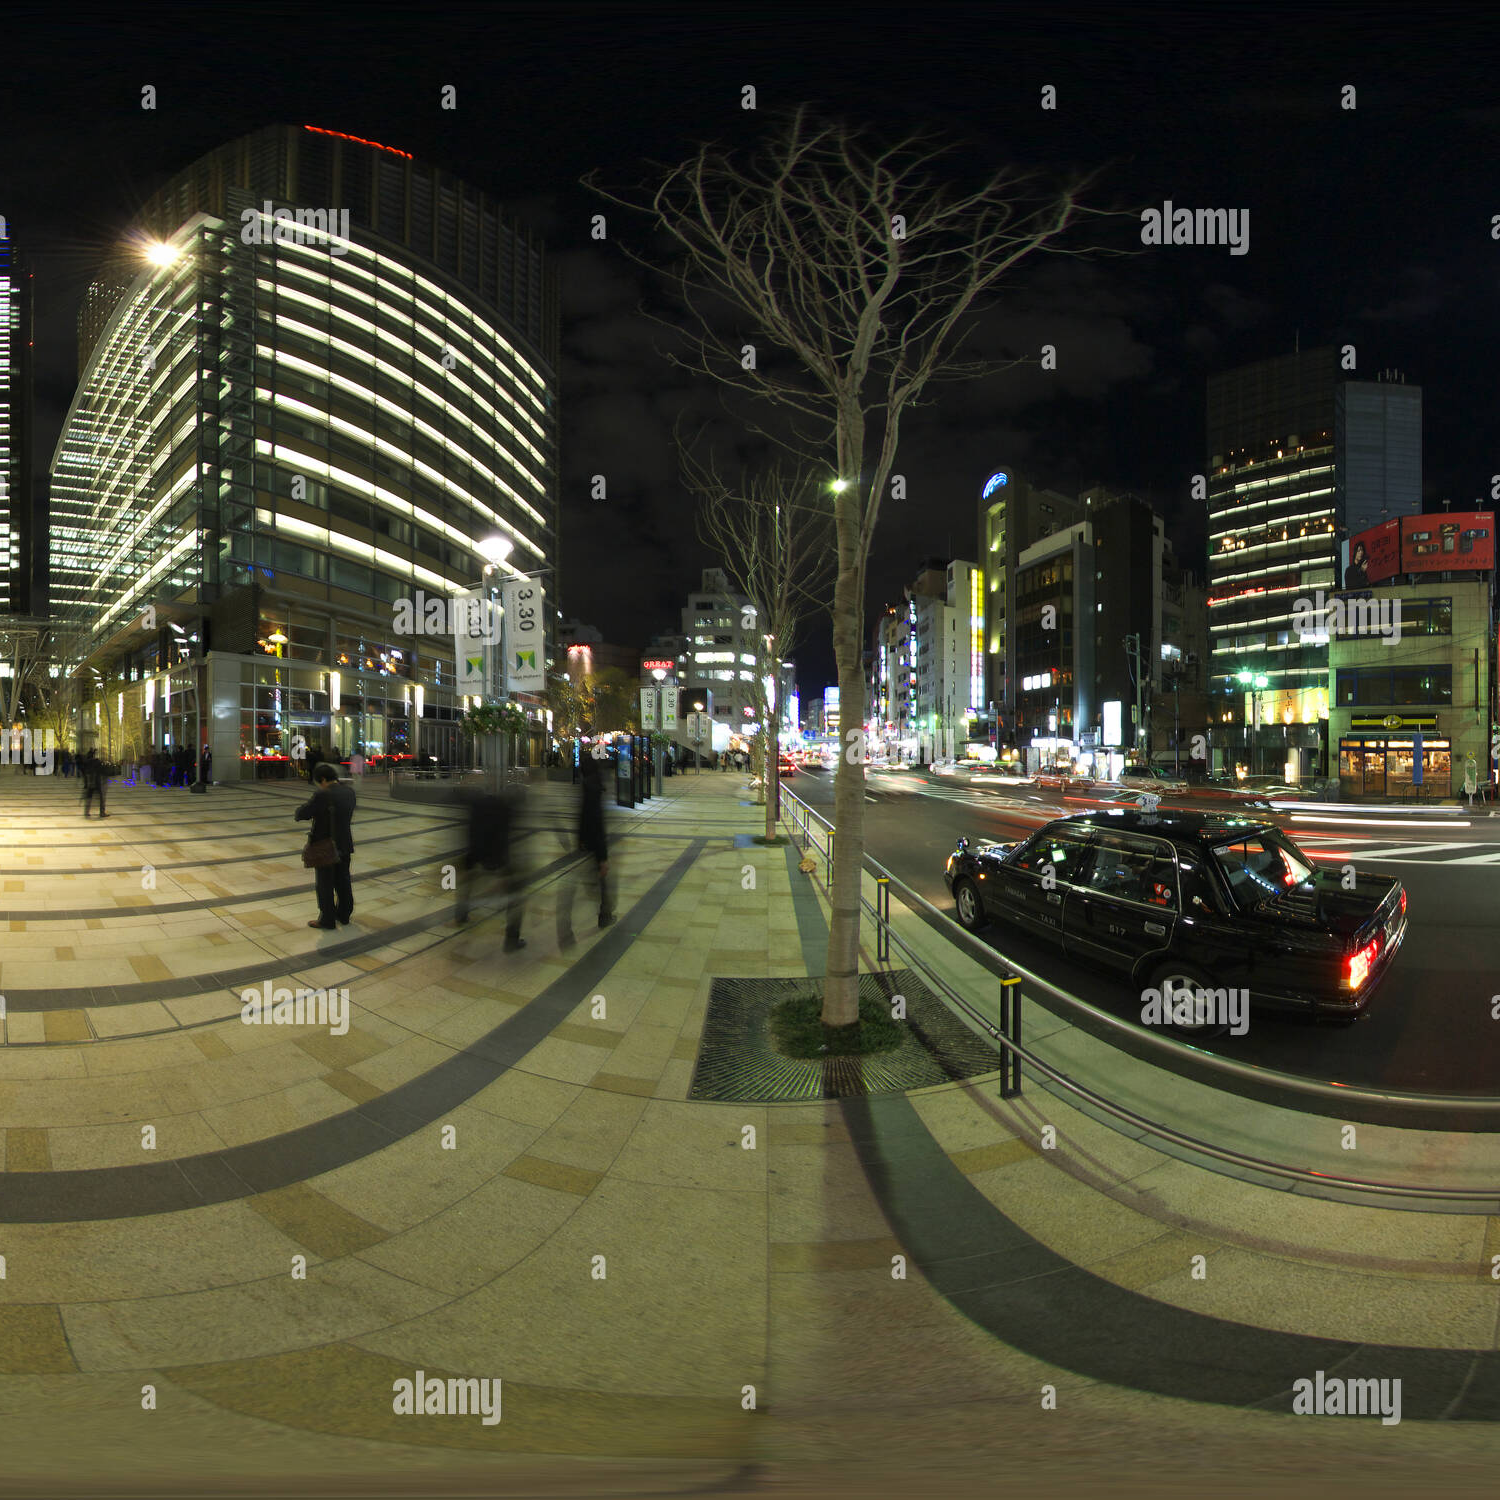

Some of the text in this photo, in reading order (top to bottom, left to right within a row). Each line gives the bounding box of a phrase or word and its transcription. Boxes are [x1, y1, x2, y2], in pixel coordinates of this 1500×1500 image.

[518, 588, 535, 632] 3.30
[643, 660, 675, 669] GREAT
[1040, 913, 1056, 928] TAXI
